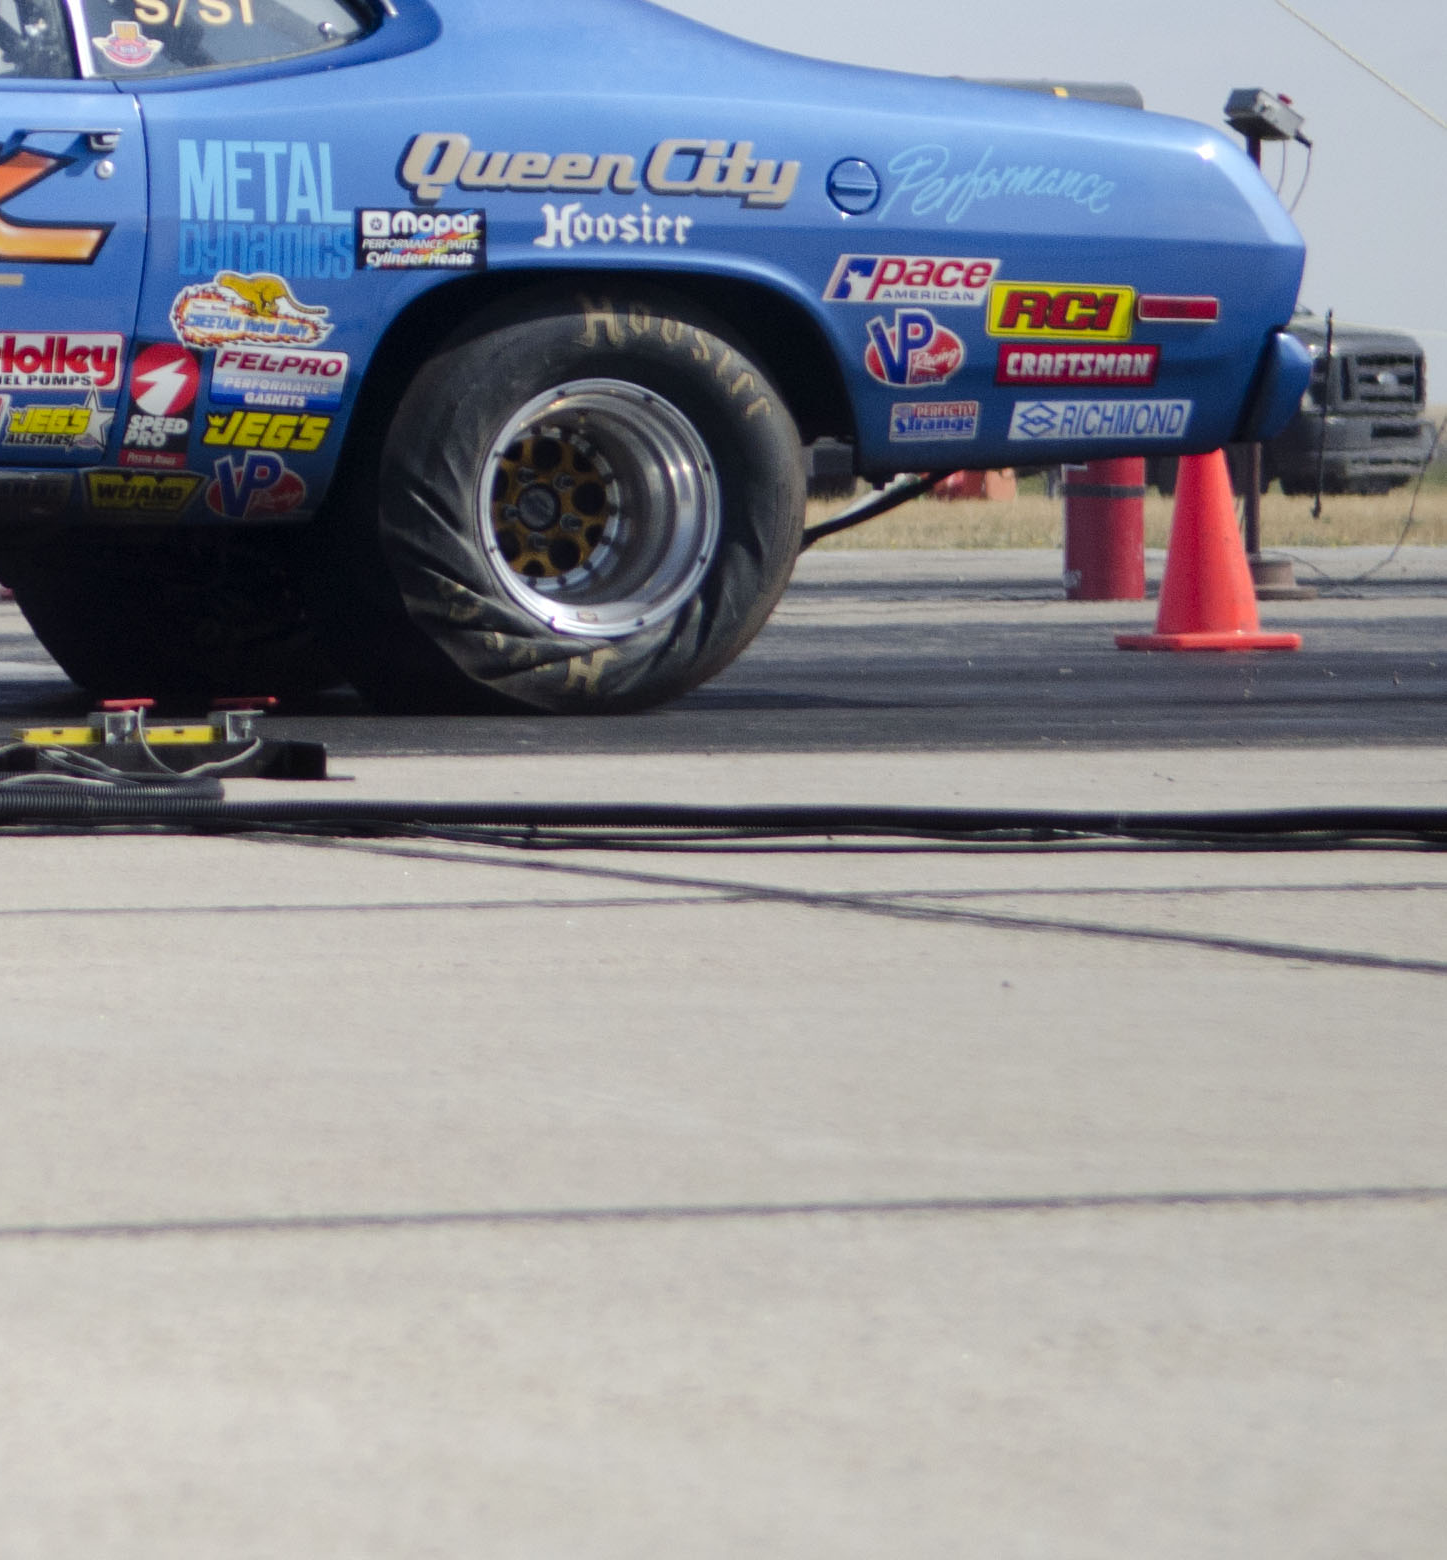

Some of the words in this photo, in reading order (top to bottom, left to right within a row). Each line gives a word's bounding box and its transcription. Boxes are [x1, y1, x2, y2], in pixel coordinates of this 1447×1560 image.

[179, 139, 353, 224] METAL
[396, 132, 639, 206] Queen
[643, 137, 801, 210] City
[877, 143, 1114, 223] Performance
[392, 210, 479, 237] Mopar
[533, 202, 693, 249] Hoosier
[366, 251, 426, 267] Cylinder
[429, 252, 474, 266] Heads
[866, 258, 994, 301] pace
[881, 290, 975, 302] AMERICAN
[867, 309, 934, 385] VP
[217, 350, 343, 378] FEL-PRO
[1005, 351, 1153, 377] CRAFTSMAN
[26, 375, 92, 387] PUMPS
[223, 376, 330, 396] PERFORMANCE
[243, 392, 307, 408] GASKETS
[8, 406, 92, 435] JEG'S
[129, 414, 190, 435] SPEED
[204, 410, 331, 452] JEG'S
[1060, 403, 1186, 435] RICHMOND
[122, 430, 169, 447] PRO
